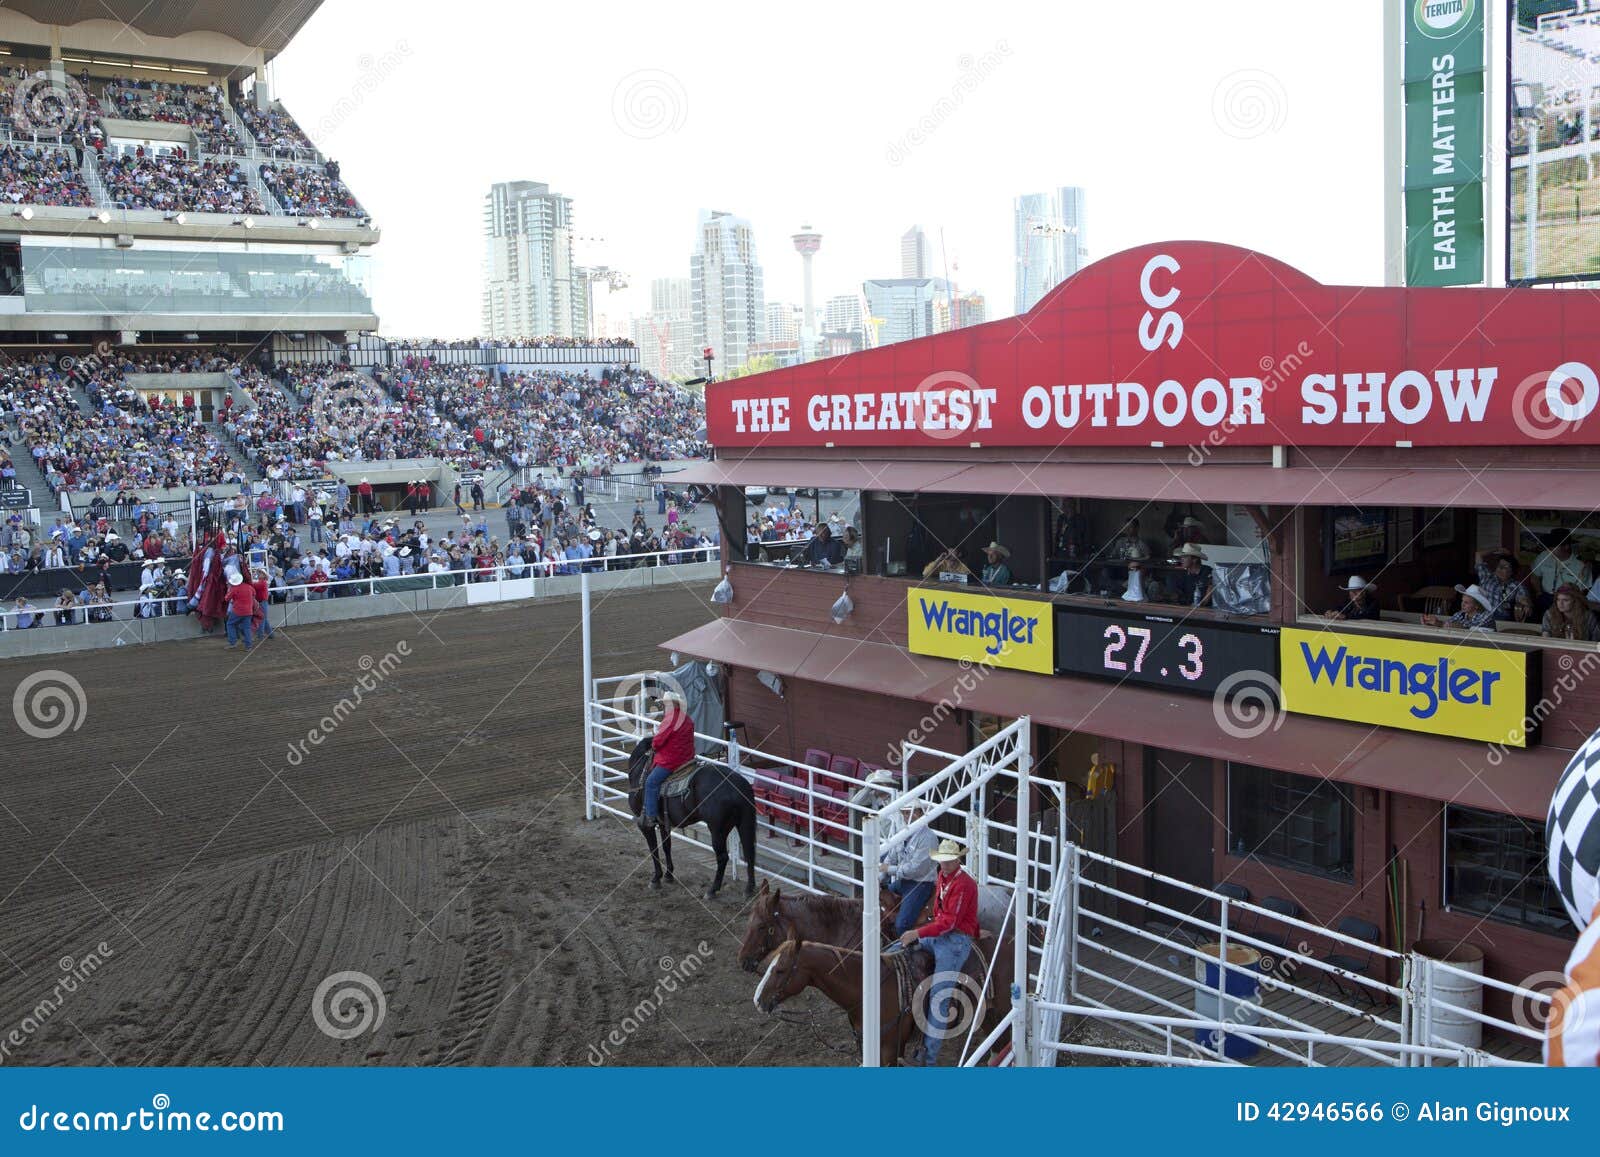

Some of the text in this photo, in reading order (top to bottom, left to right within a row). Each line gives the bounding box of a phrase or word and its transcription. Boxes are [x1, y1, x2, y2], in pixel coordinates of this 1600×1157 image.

[1425, 1, 1463, 18] TERVITA
[1432, 53, 1456, 271] EARTH MATTERS
[731, 397, 790, 433] THE
[807, 388, 997, 432] GREATEST
[1021, 377, 1265, 429] OUTDOOR
[1300, 366, 1498, 425] SHOW
[919, 597, 1038, 655] Wrangler
[1299, 641, 1500, 719] Wrangler
